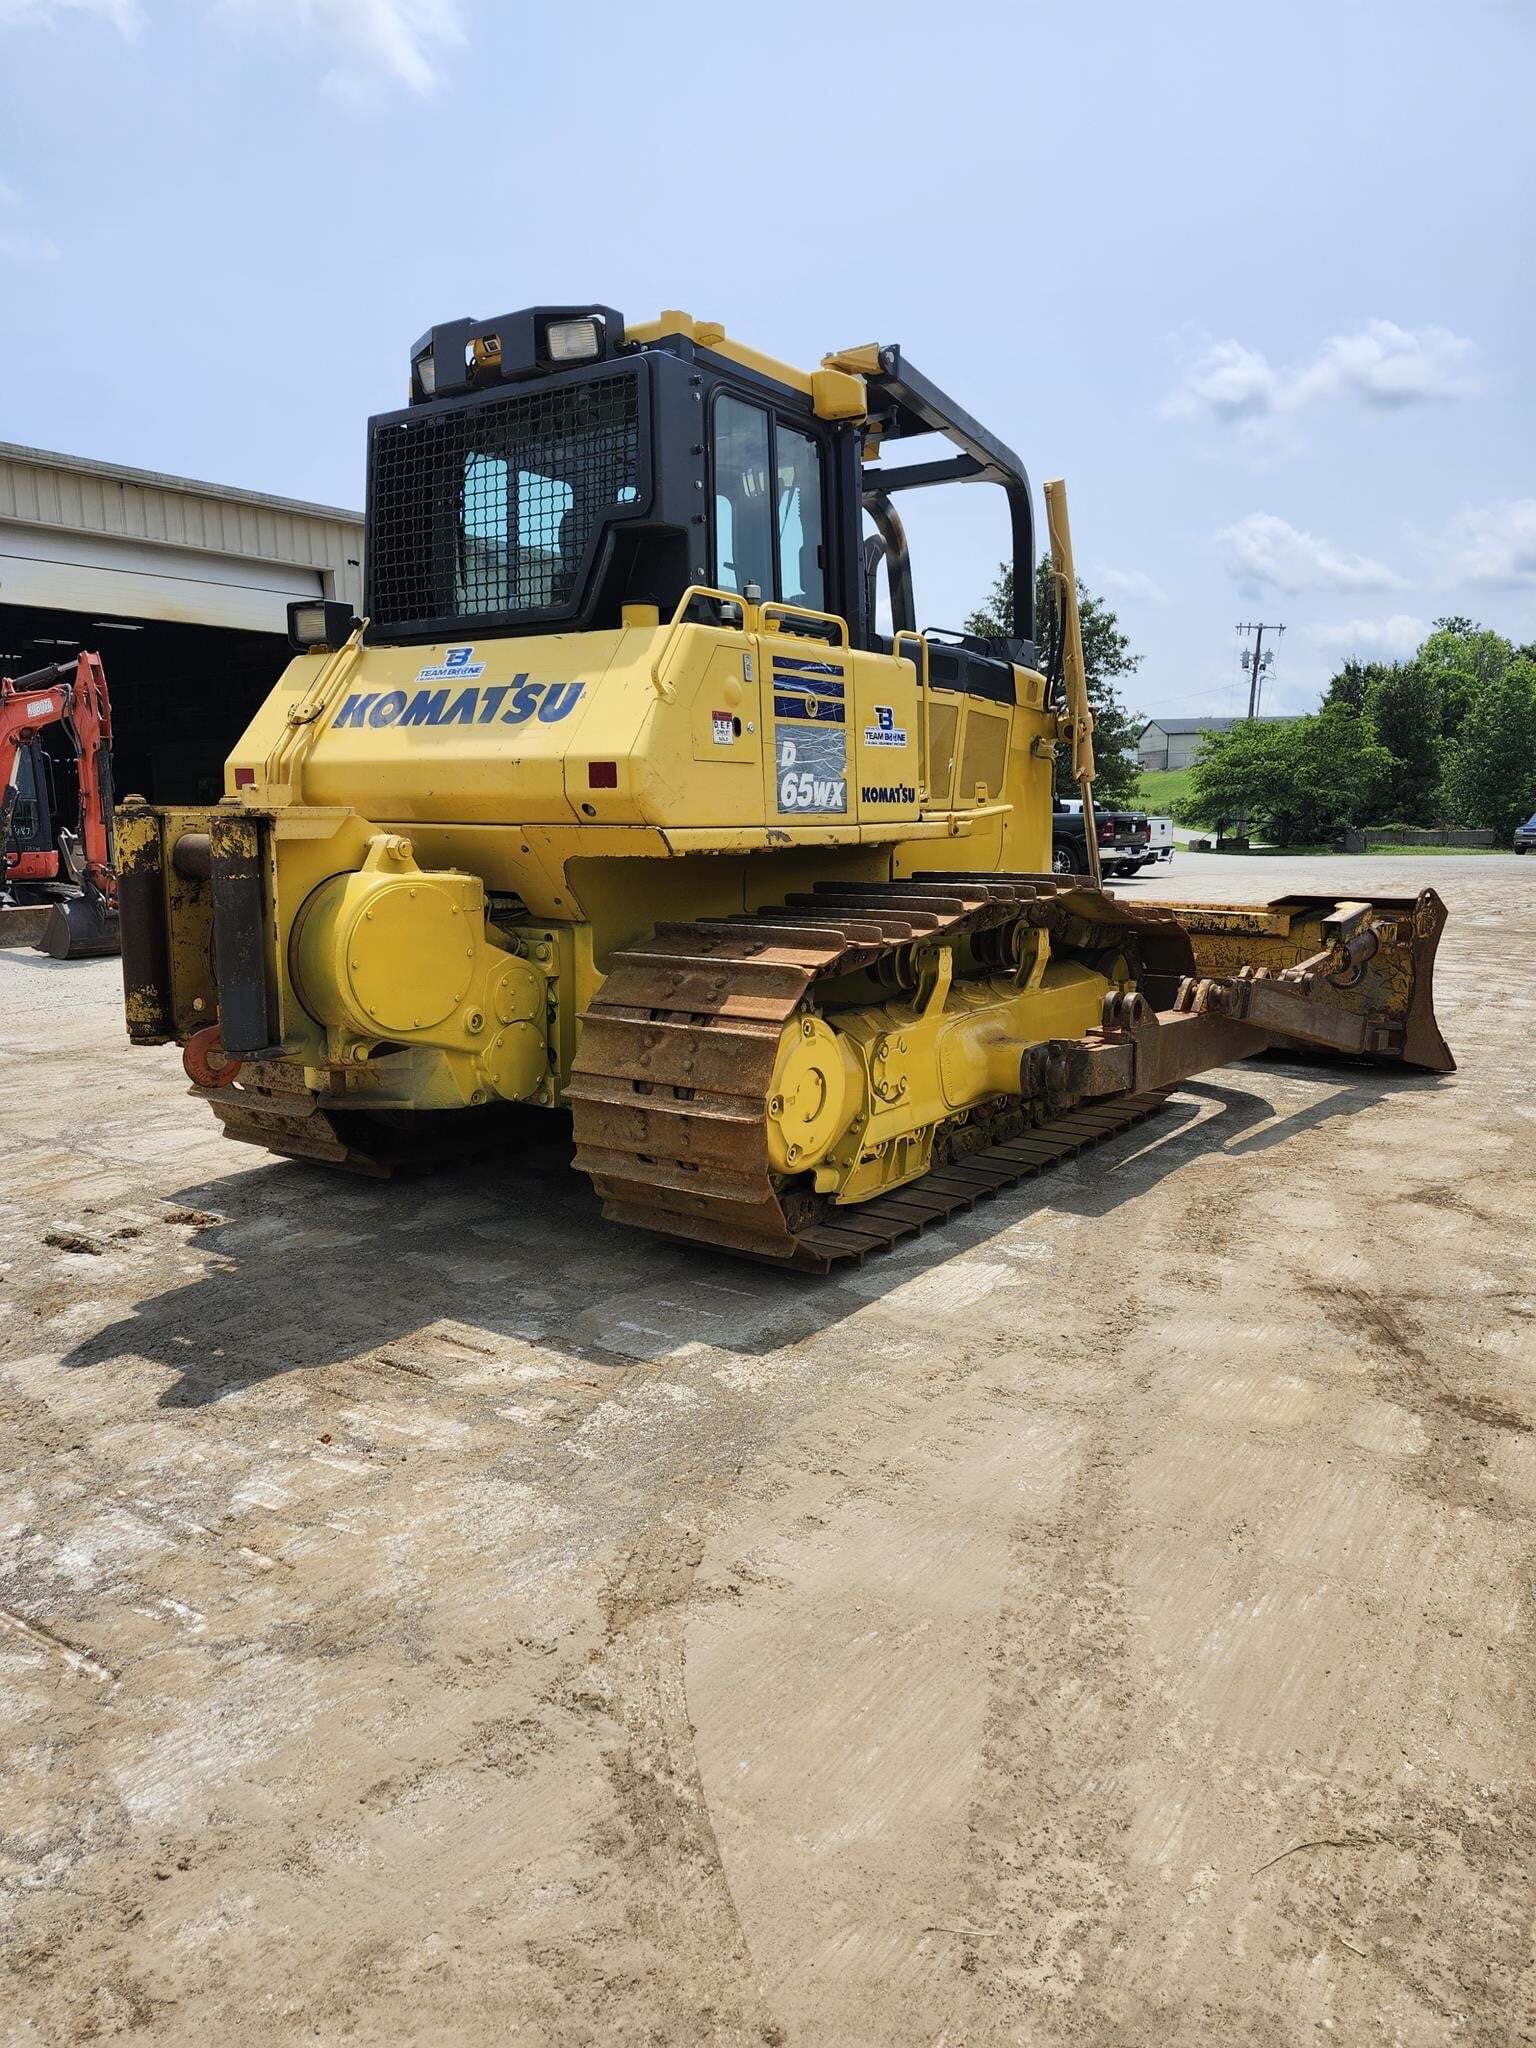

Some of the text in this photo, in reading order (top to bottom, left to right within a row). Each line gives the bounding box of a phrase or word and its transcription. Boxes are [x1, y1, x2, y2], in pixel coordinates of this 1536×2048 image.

[420, 669, 447, 677] TEAM
[331, 673, 586, 729] KOMATSU
[865, 731, 884, 740] TEAM
[781, 740, 797, 767] D
[780, 772, 845, 807] 65WX
[861, 783, 916, 803] KOMATSU
